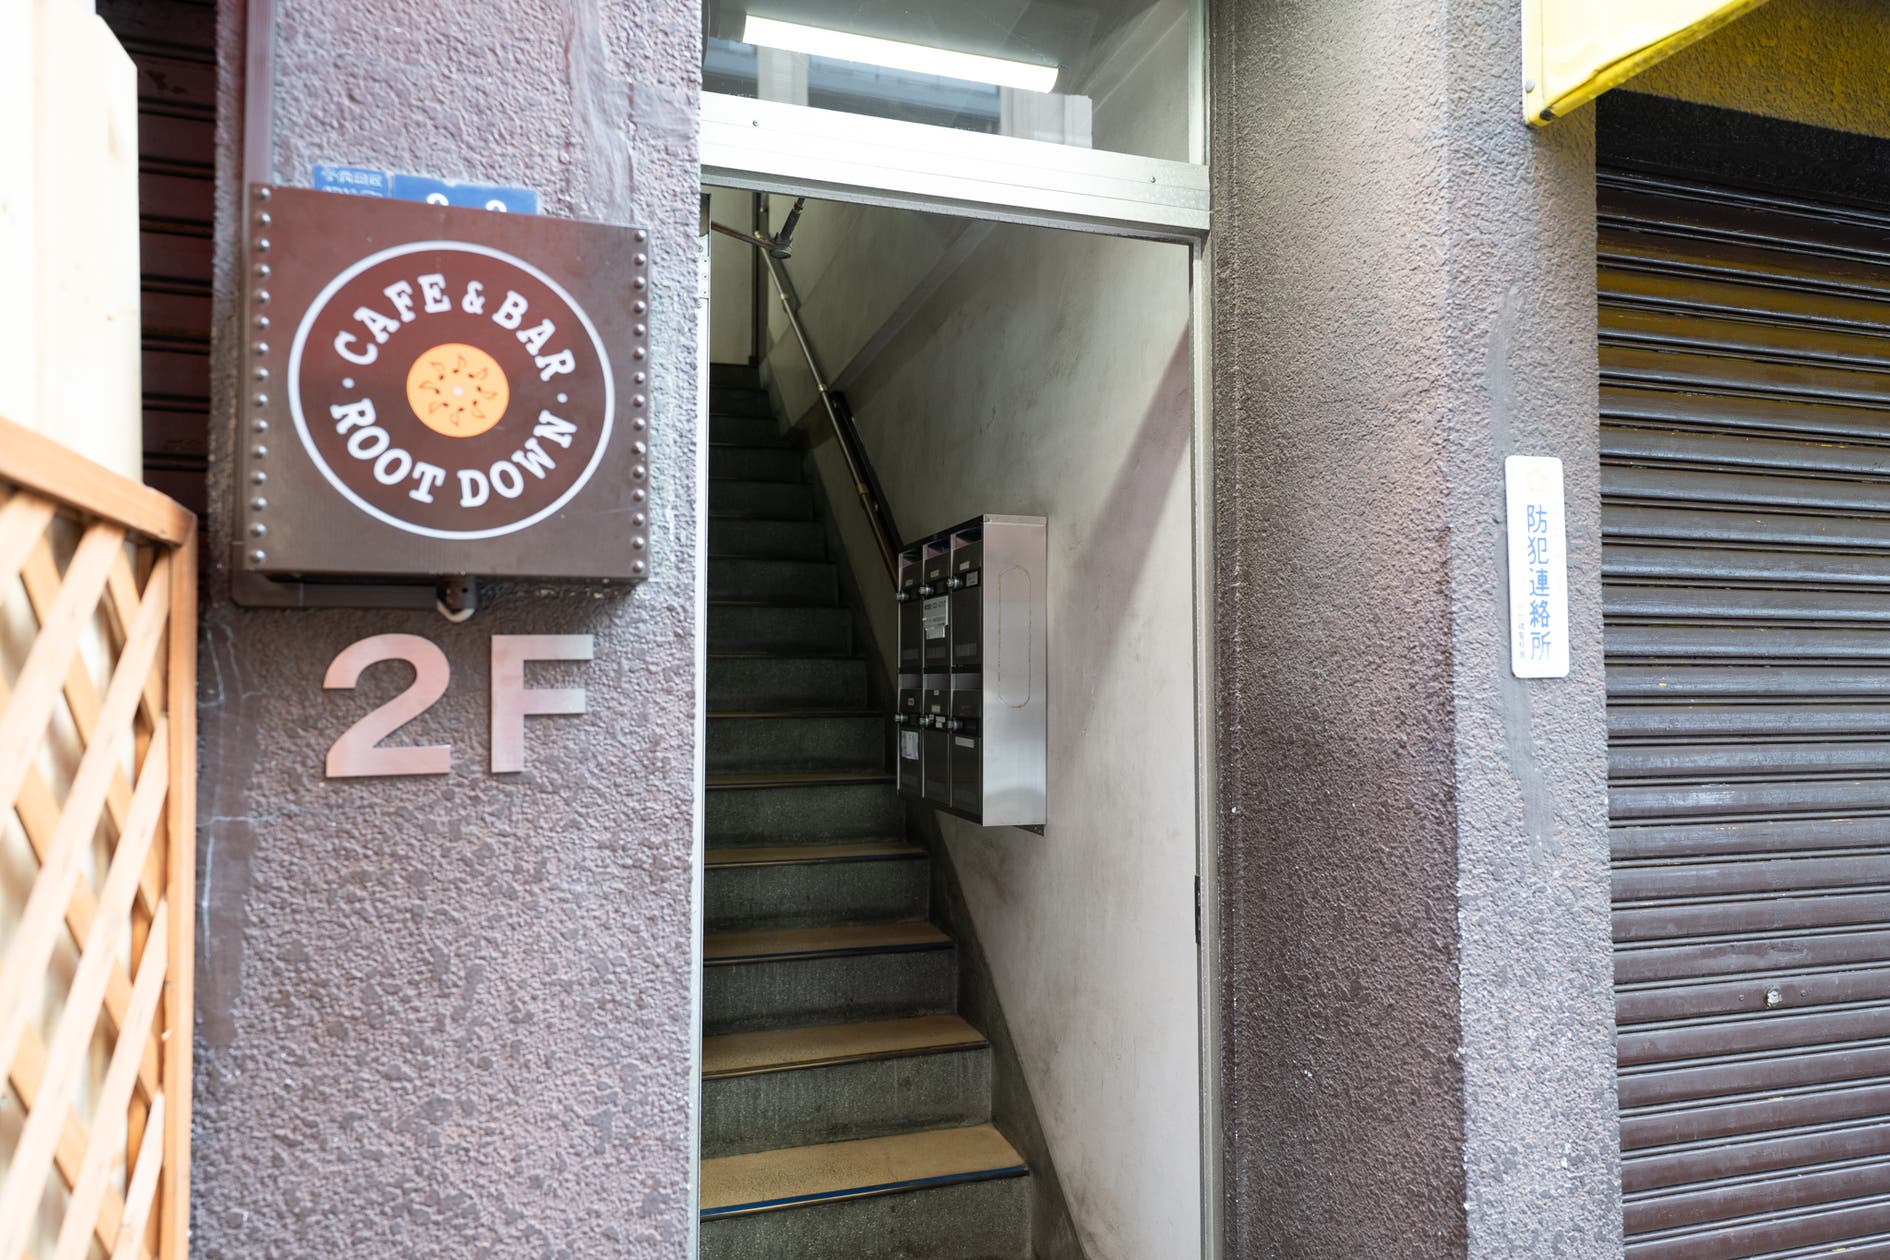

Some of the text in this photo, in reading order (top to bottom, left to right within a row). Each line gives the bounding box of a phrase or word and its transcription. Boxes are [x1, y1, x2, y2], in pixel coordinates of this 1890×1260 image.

[334, 273, 577, 382] CAFE & BAR
[330, 397, 578, 508] ROOT DOWN
[1527, 504, 1552, 661] 防犯連絡所
[322, 632, 594, 778] 2F
